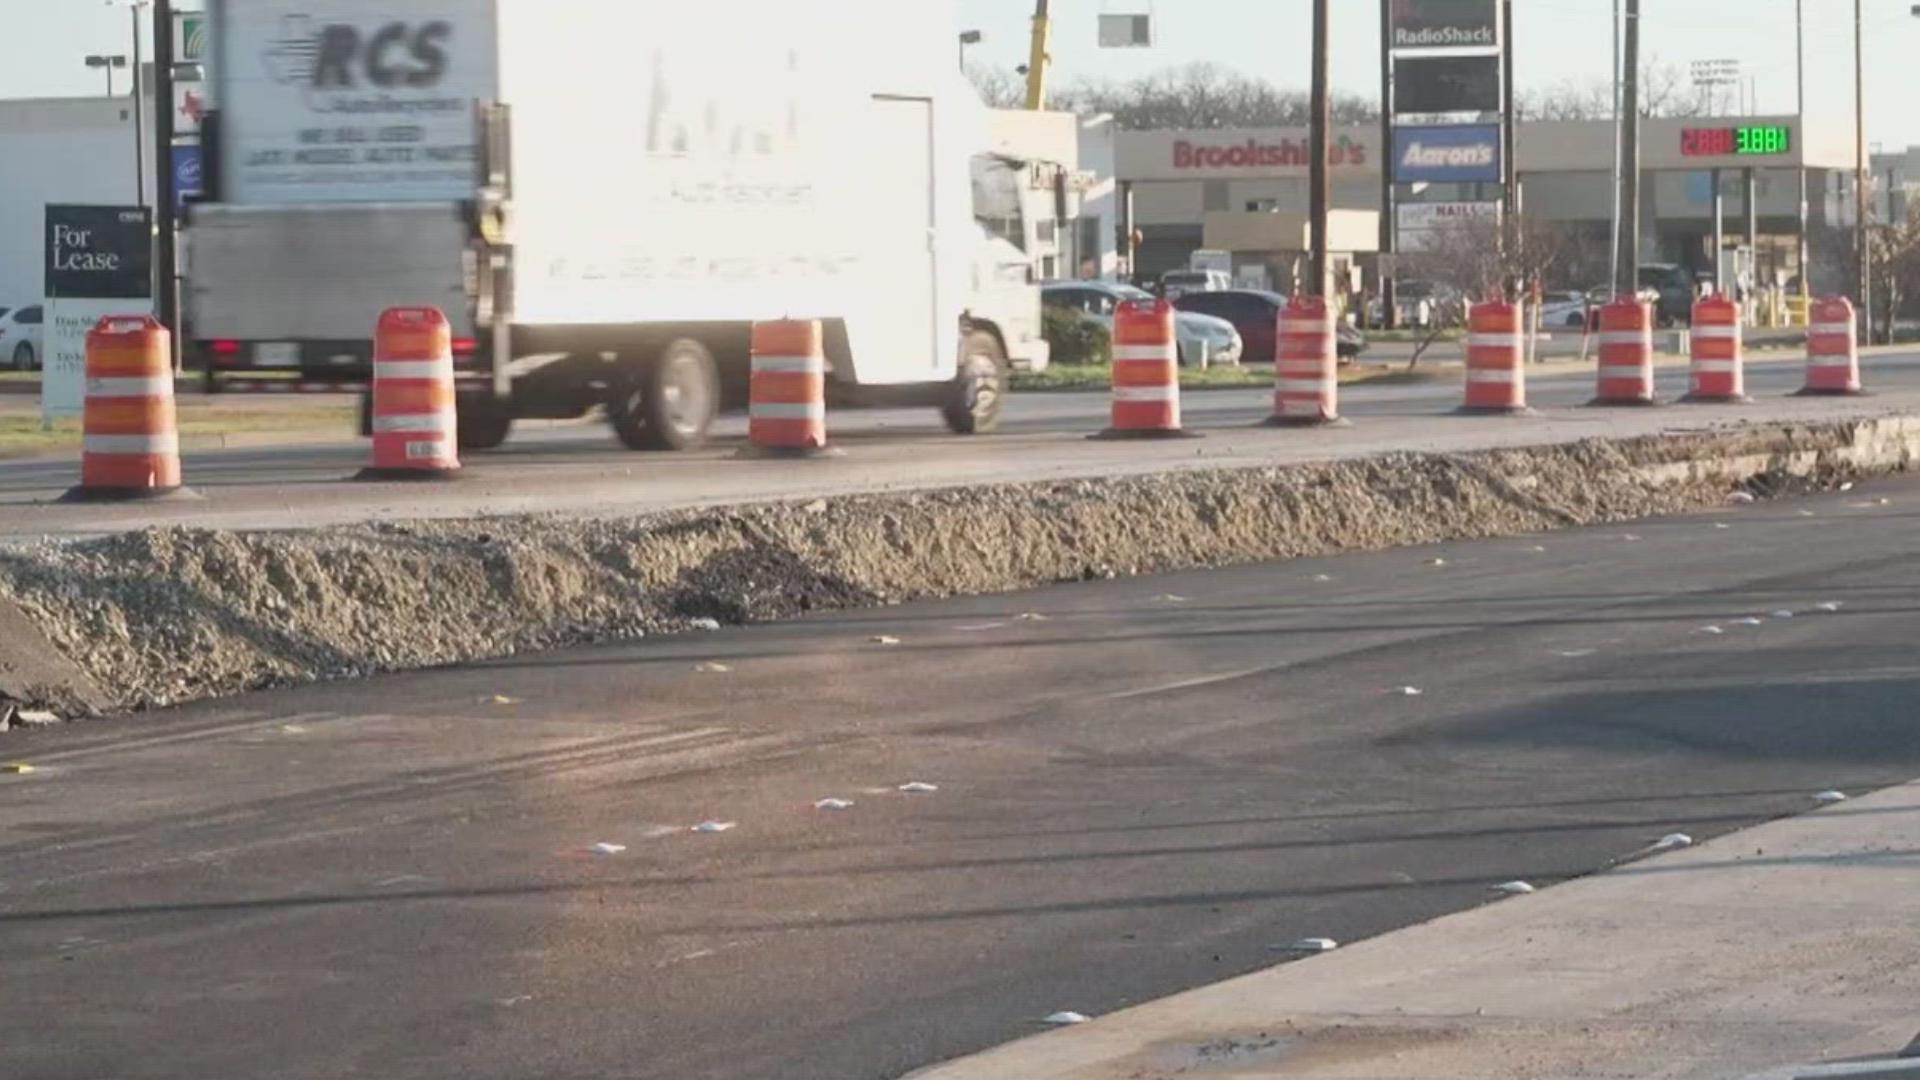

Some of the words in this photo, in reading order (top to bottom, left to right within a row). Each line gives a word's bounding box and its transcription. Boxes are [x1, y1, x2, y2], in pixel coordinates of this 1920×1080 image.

[1395, 26, 1493, 44] RadioShack
[312, 20, 452, 89] RCS
[1402, 141, 1493, 167] Aaron's
[1436, 205, 1478, 217] NAILS
[53, 223, 91, 248] For
[53, 247, 120, 271] Lease
